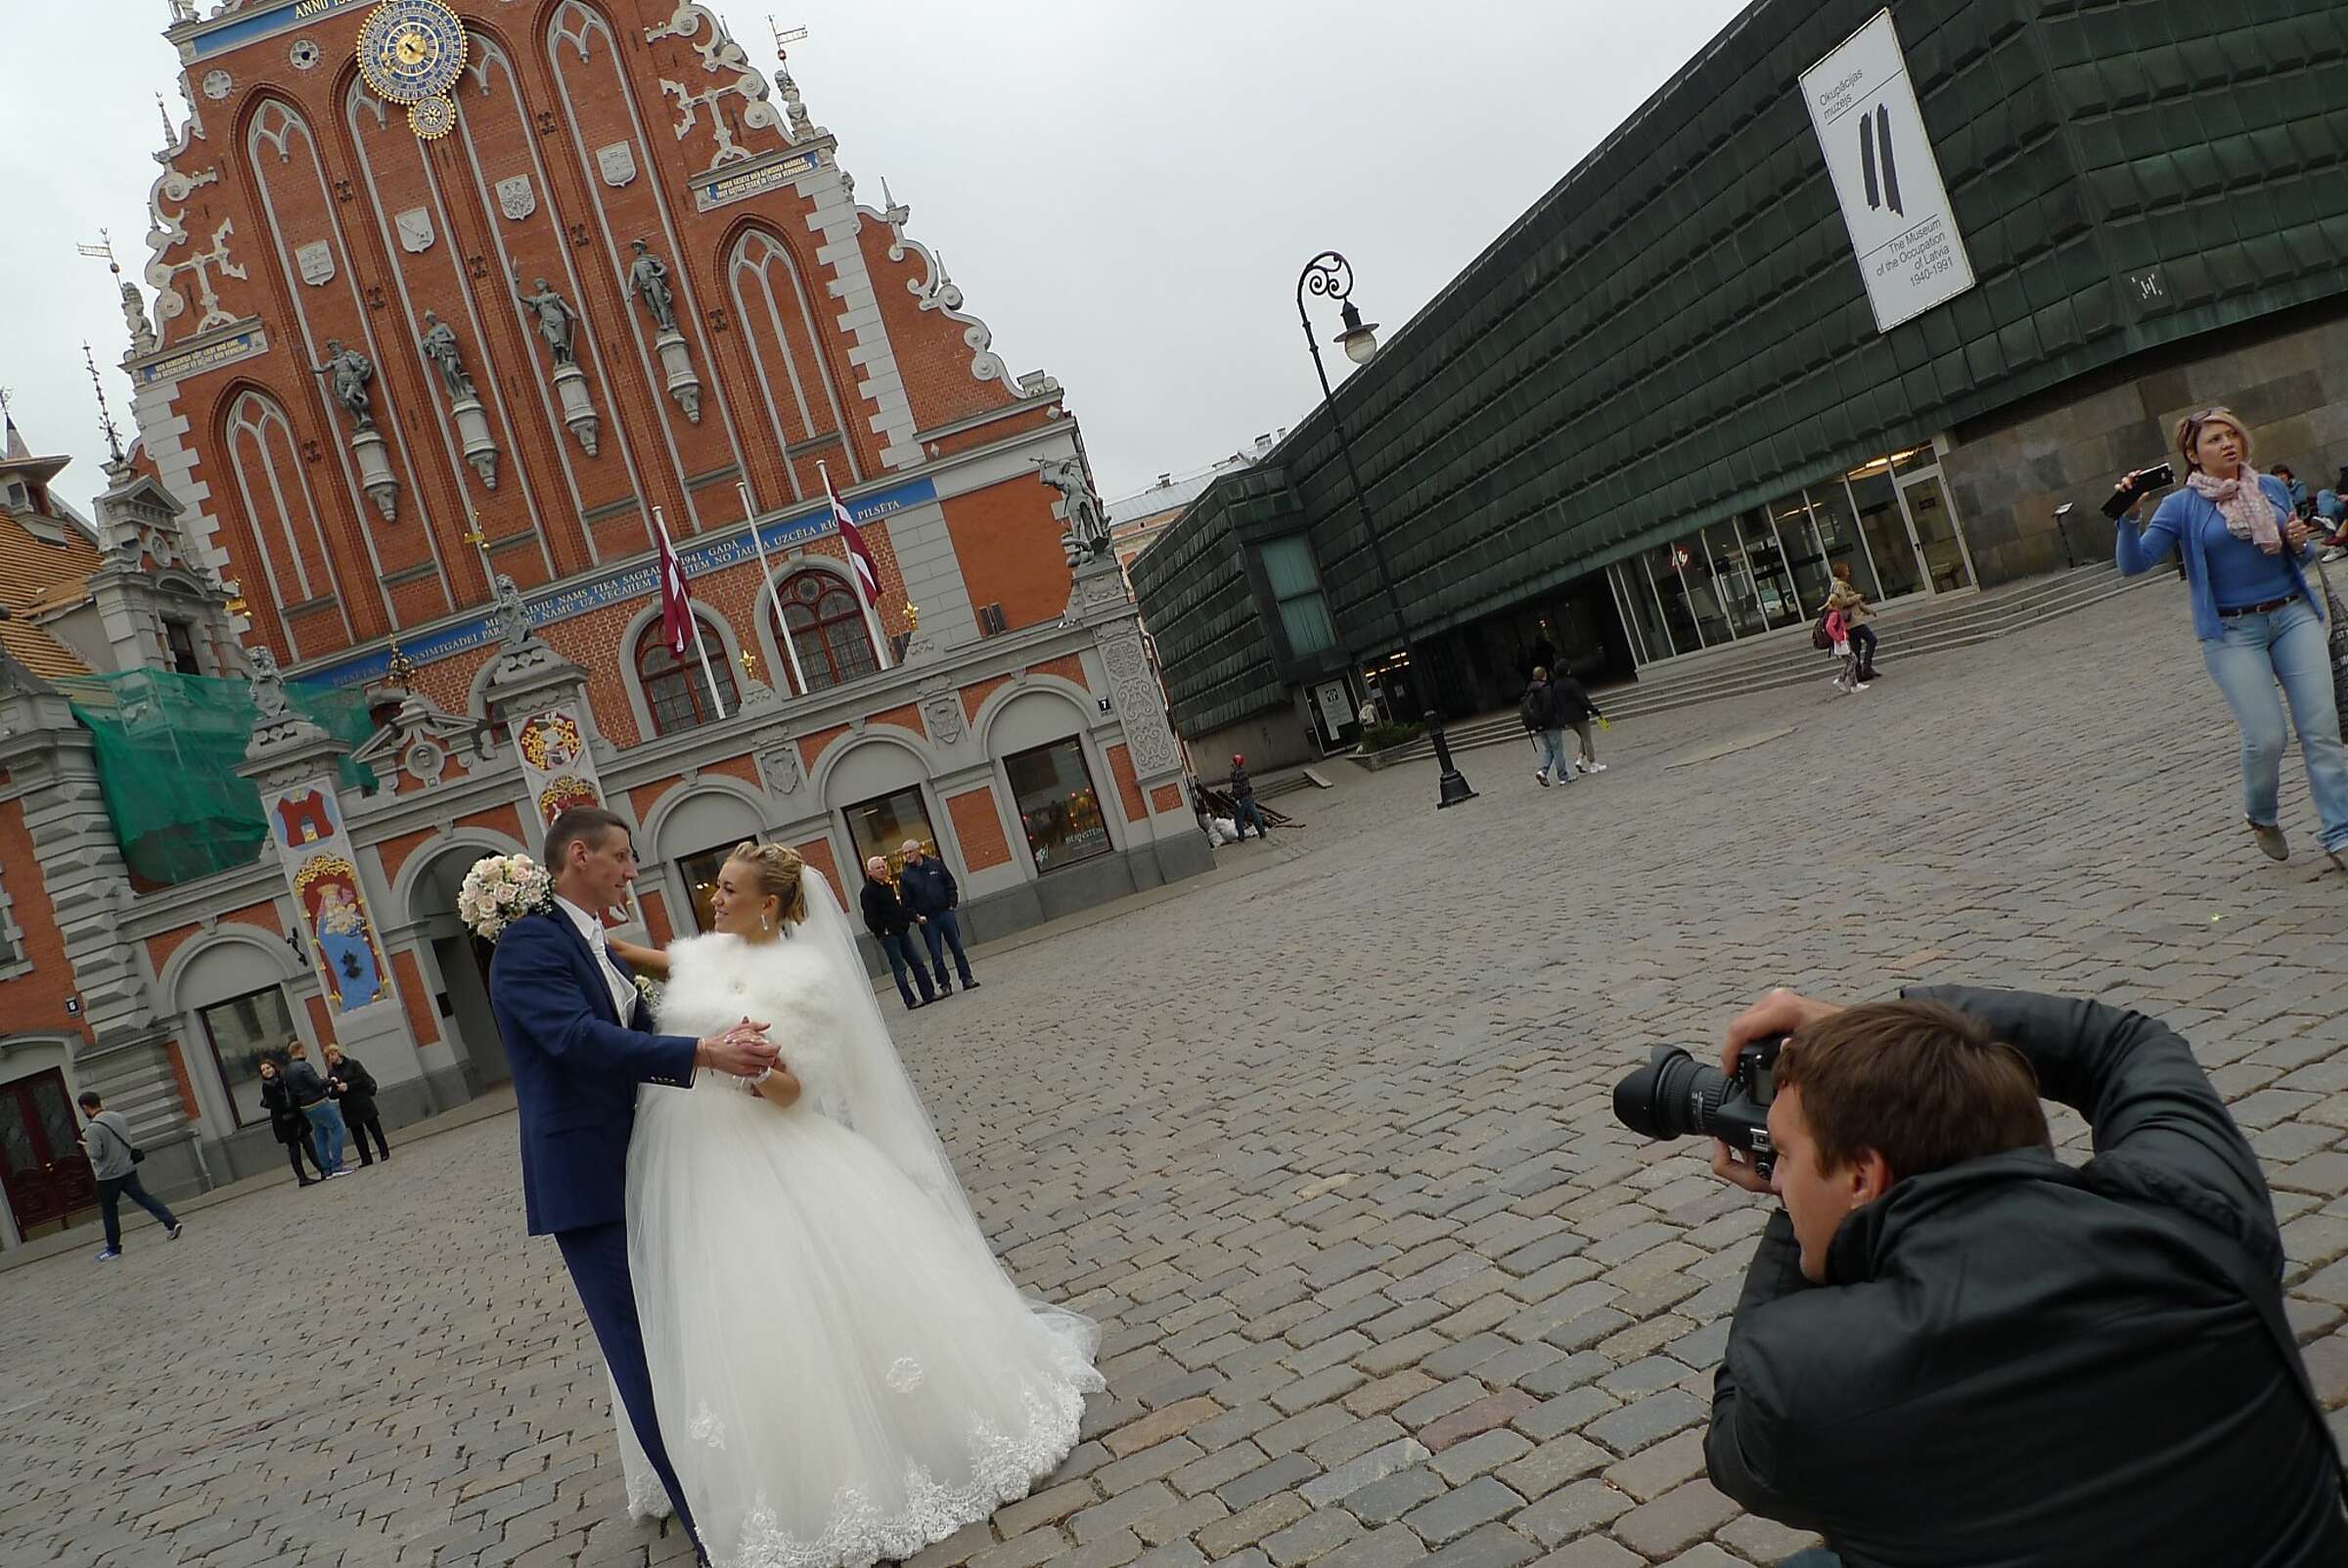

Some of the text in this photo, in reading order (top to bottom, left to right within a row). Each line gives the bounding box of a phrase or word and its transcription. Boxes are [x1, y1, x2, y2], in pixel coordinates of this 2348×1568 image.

[295, 0, 329, 19] ANNO
[1820, 69, 1863, 106] Okupācijas
[1824, 94, 1852, 119] muzejs
[1888, 219, 1942, 254] The Museum
[1876, 232, 1946, 277] of the Occupation
[1915, 245, 1950, 270] of Latvia
[1910, 256, 1954, 288] 1940-1991
[541, 603, 574, 621] NAMU
[579, 596, 596, 607] UZ
[714, 553, 732, 565] NO
[736, 540, 771, 560] JAUA
[559, 587, 588, 606] NAMS
[591, 578, 618, 594] TIKA
